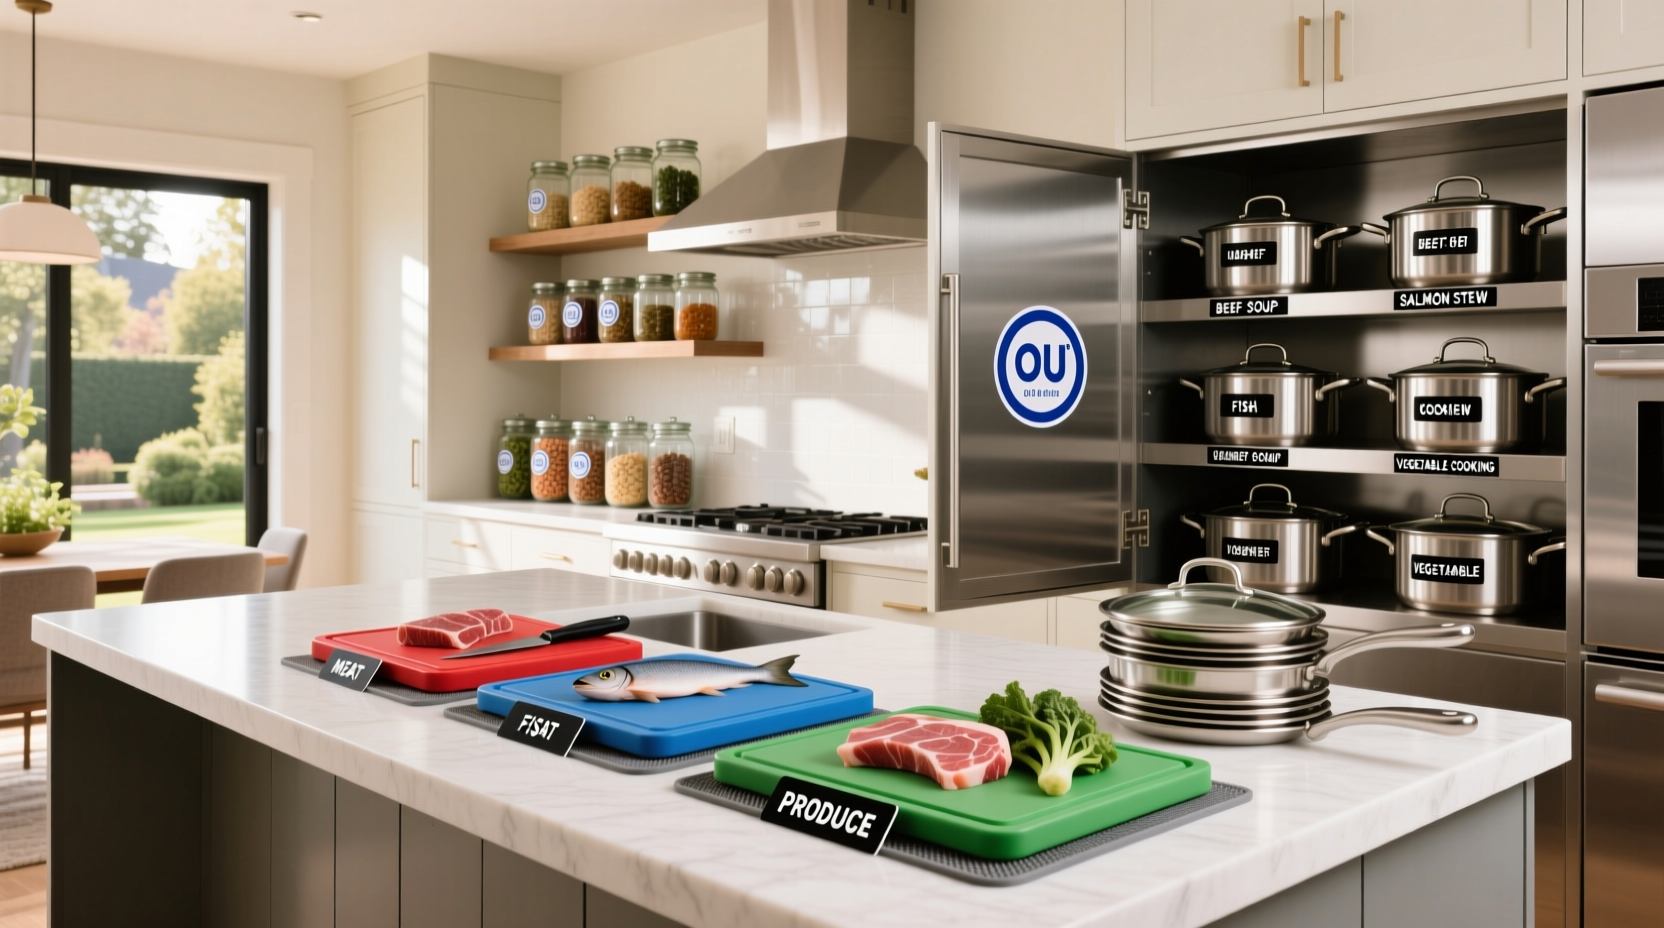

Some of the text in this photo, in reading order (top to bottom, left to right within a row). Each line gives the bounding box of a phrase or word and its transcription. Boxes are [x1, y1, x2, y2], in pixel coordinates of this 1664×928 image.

[1400, 290, 1488, 307] SALMON STEW
[1216, 300, 1279, 315] BEEF SOUP
[1232, 400, 1258, 413] FISH
[1450, 460, 1495, 473] COOKING
[330, 658, 366, 680] MEAT
[777, 790, 877, 839] PRODUCE
